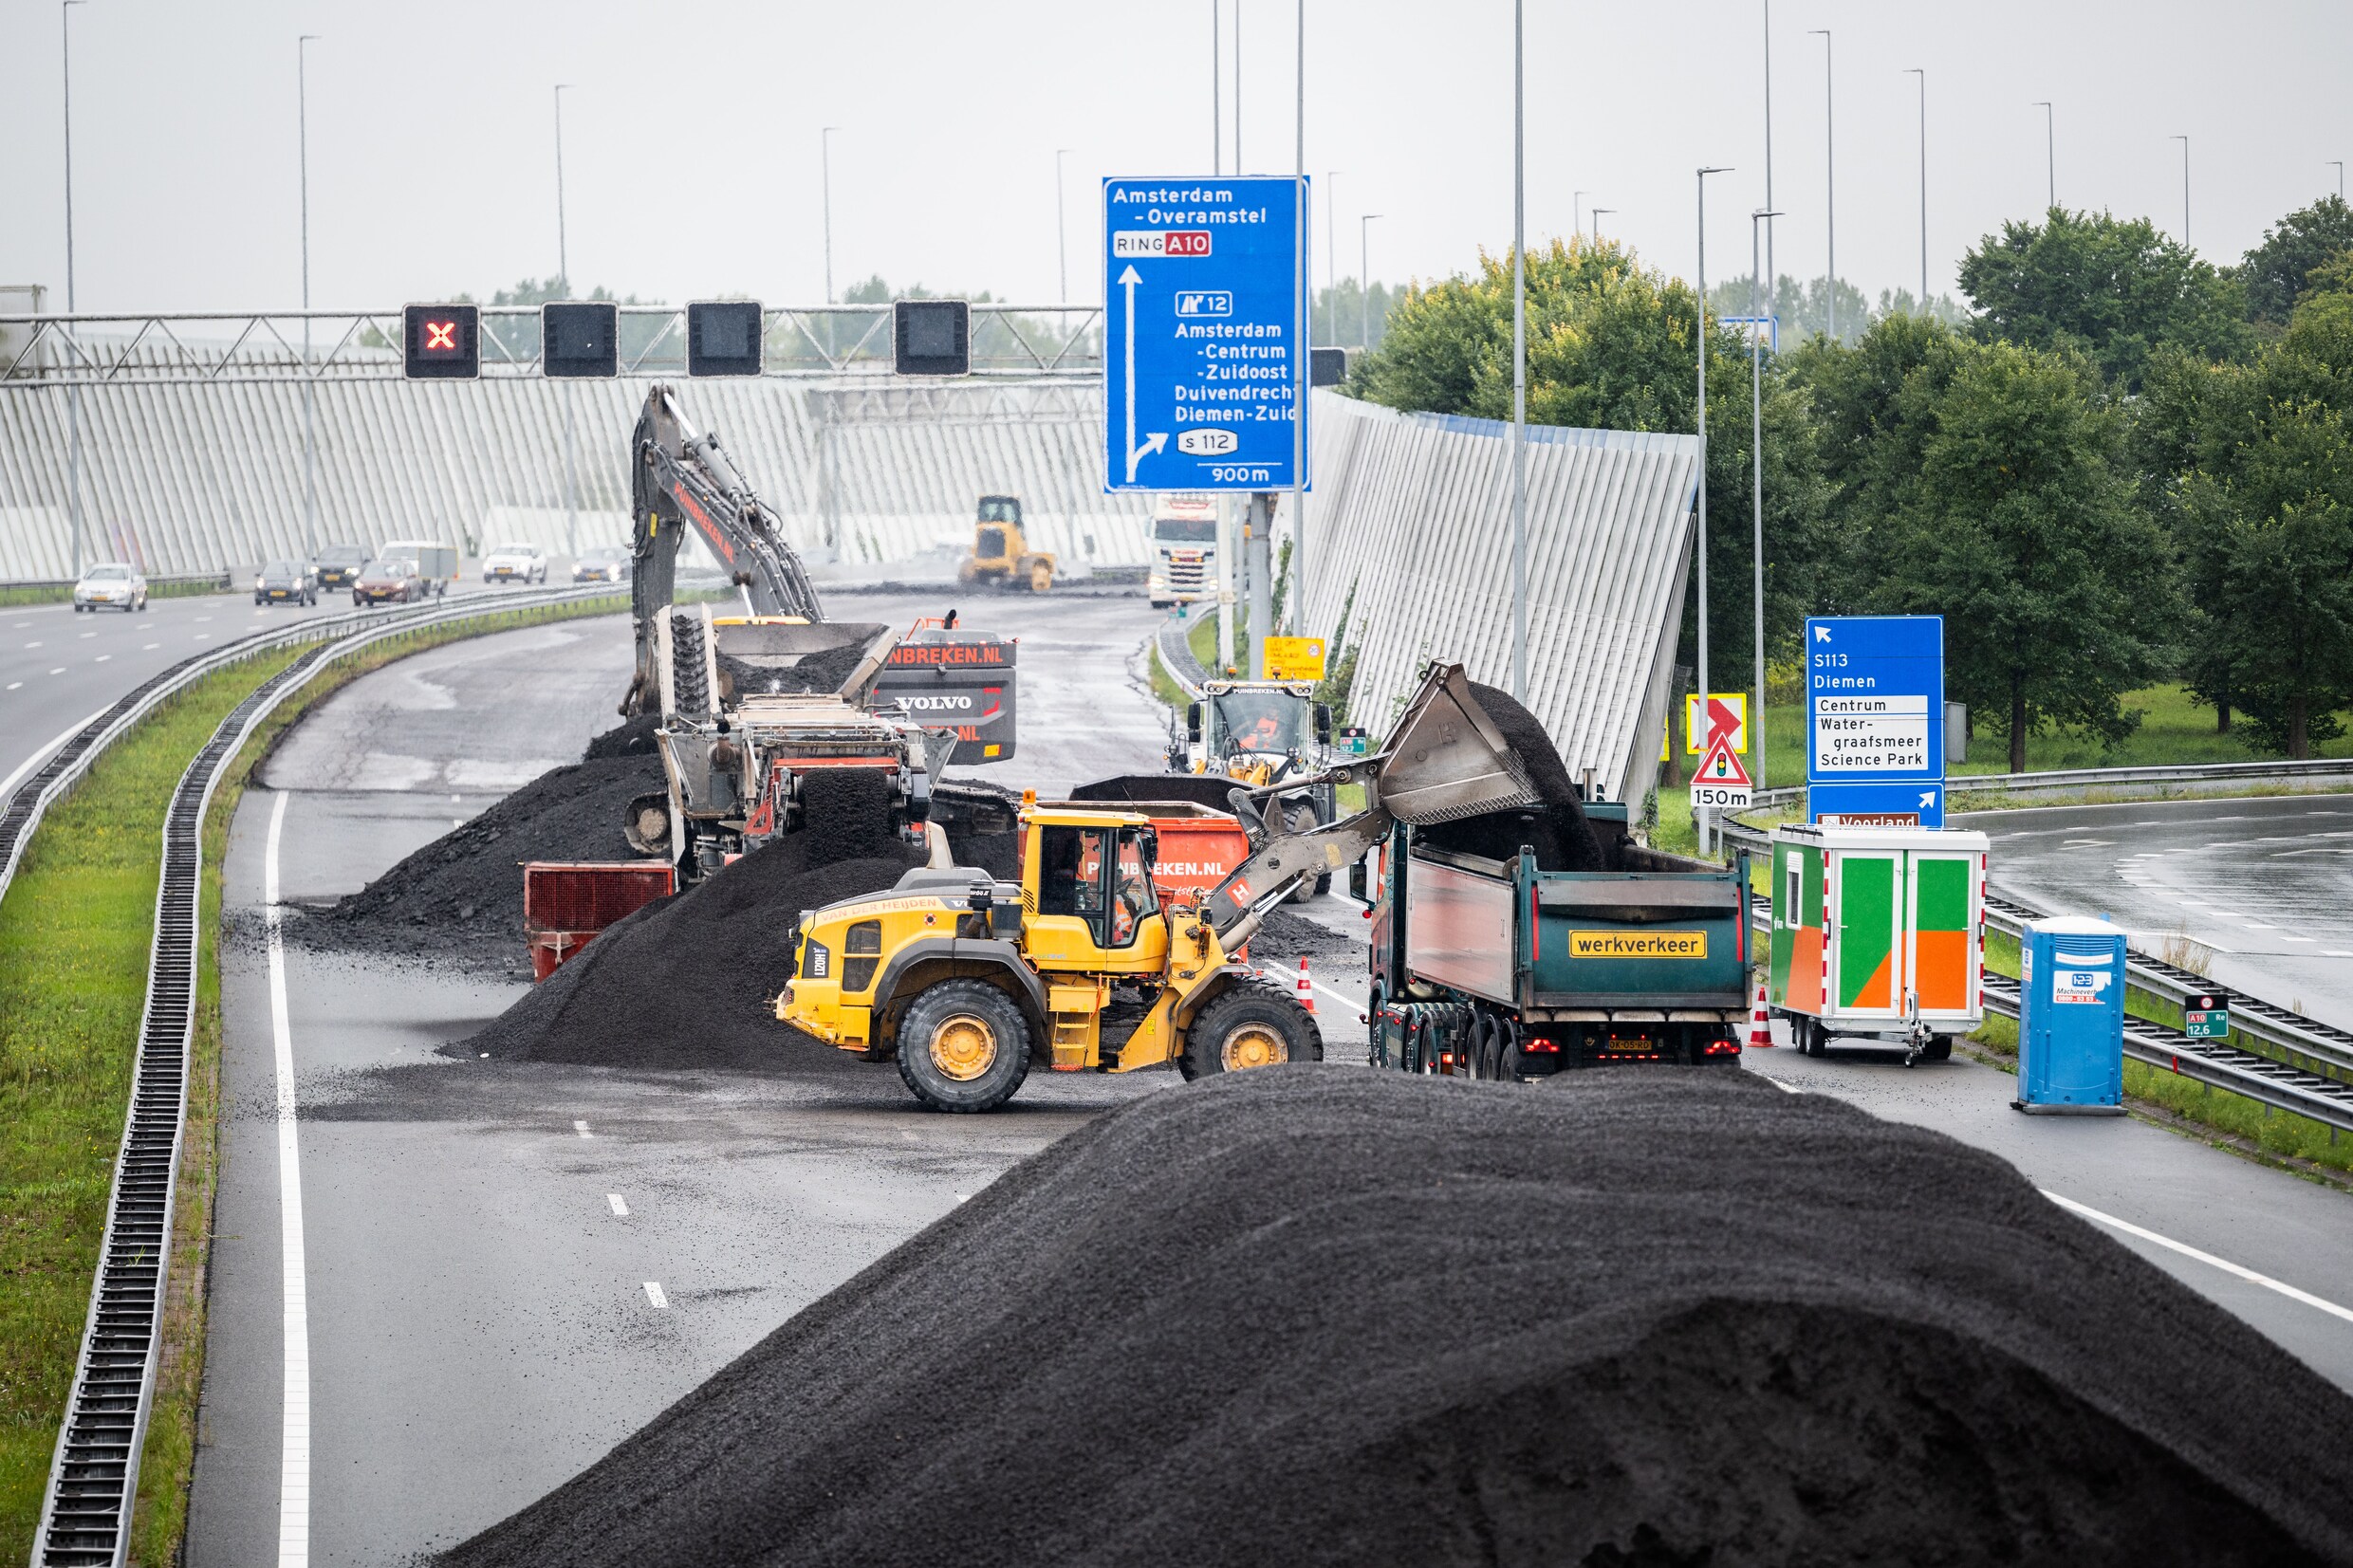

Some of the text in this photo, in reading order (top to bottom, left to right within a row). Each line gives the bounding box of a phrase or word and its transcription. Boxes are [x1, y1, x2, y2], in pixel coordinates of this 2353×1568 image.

[1113, 187, 1232, 203] Amsterdam
[1135, 207, 1266, 224] -Overamstel
[1118, 236, 1207, 251] RING A10
[1208, 296, 1227, 311] 12
[1175, 323, 1281, 338] Amsterdam
[1197, 344, 1286, 359] -Centrum
[1197, 365, 1288, 380] -Zuidoost
[1175, 385, 1295, 401] Duivendrech
[674, 481, 736, 564] PUINBREKEN.NL
[888, 647, 1003, 664] NBREKEN.NL
[1814, 654, 1848, 667] S113
[1815, 675, 1875, 688] Diemen
[895, 696, 972, 710] VOLVO
[1820, 700, 1886, 711] Centrum
[1821, 718, 1873, 730] Water-
[1834, 736, 1921, 751] graafsmeer
[1821, 753, 1922, 766] Science Park
[1088, 862, 1226, 875] PNBEKEN.NL
[821, 899, 936, 921] VAN DER HEIJDEN
[1578, 937, 1698, 953] werkverkeer
[2189, 1025, 2210, 1035] 12,6
